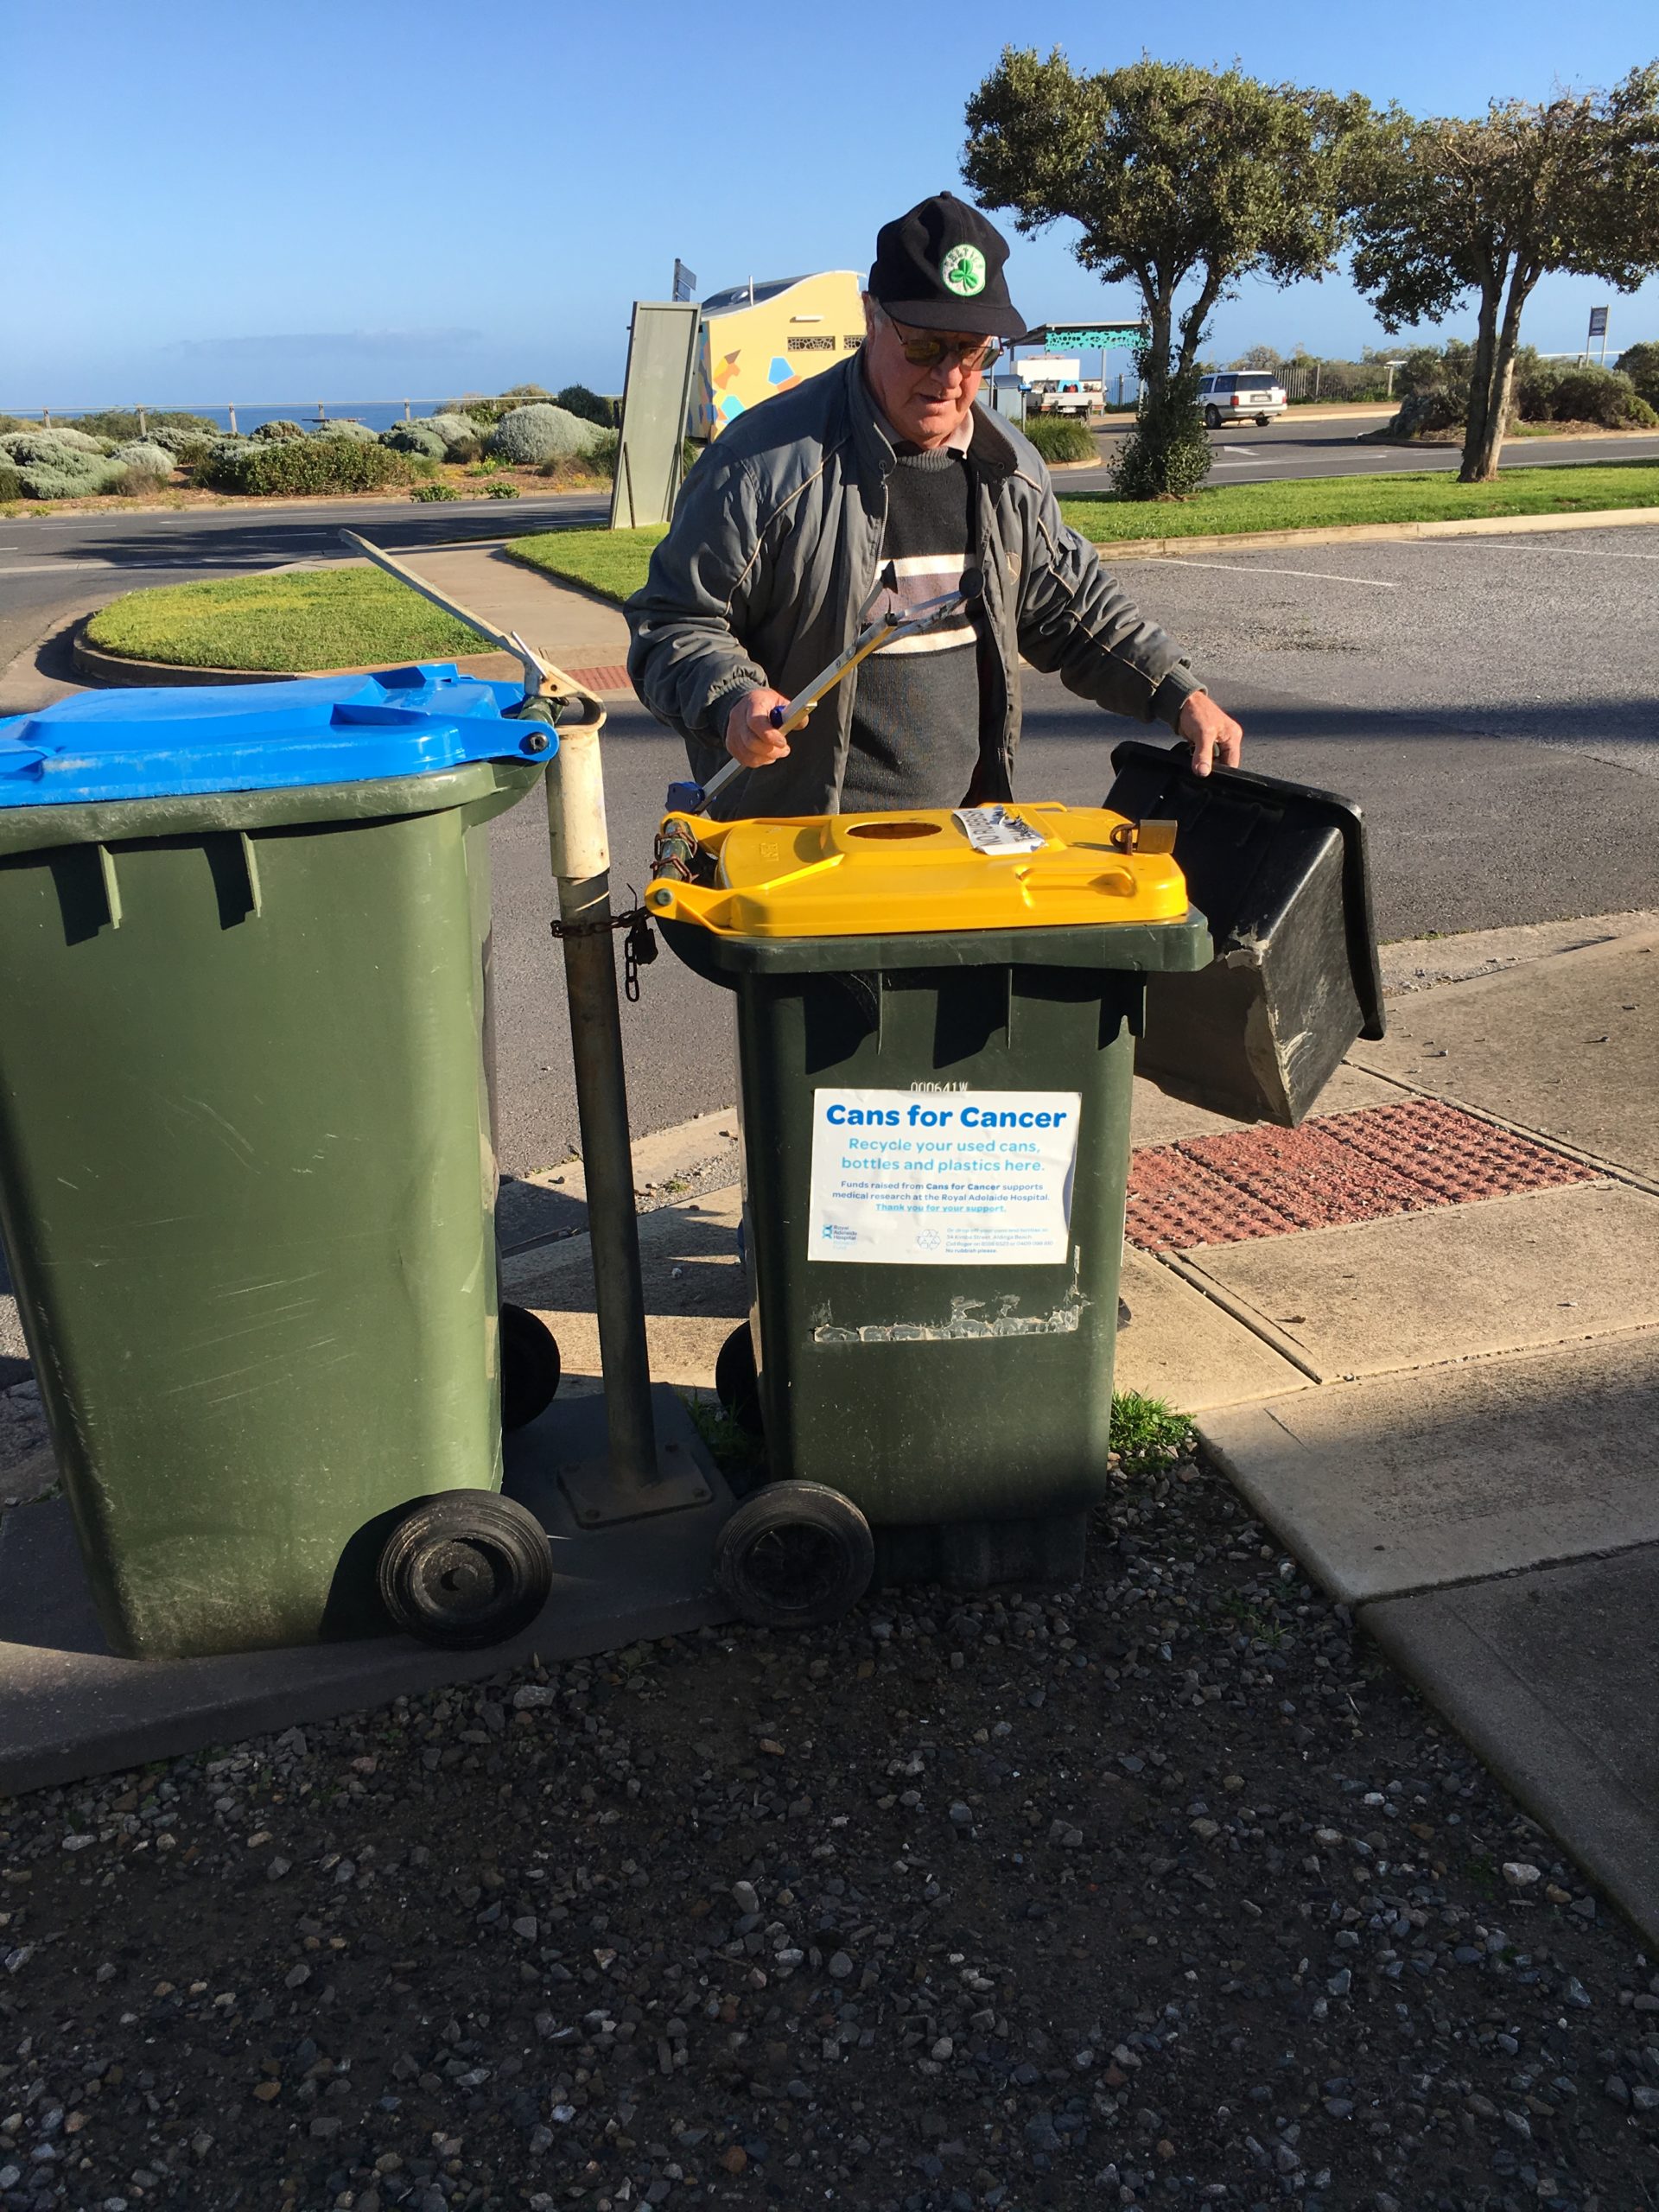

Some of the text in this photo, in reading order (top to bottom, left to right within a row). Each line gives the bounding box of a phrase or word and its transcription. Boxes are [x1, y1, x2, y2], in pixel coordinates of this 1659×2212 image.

[976, 835, 1003, 846] NO
[826, 1104, 1066, 1128] Cans for Cancer
[849, 1138, 1040, 1154] Recycle your used cans,
[842, 1157, 1045, 1173] bottles and plastics here.
[841, 1180, 868, 1189] Funds
[942, 1193, 966, 1202] Royal
[876, 1203, 905, 1211] Thank
[926, 1204, 939, 1212] for
[966, 1204, 1007, 1214] support.
